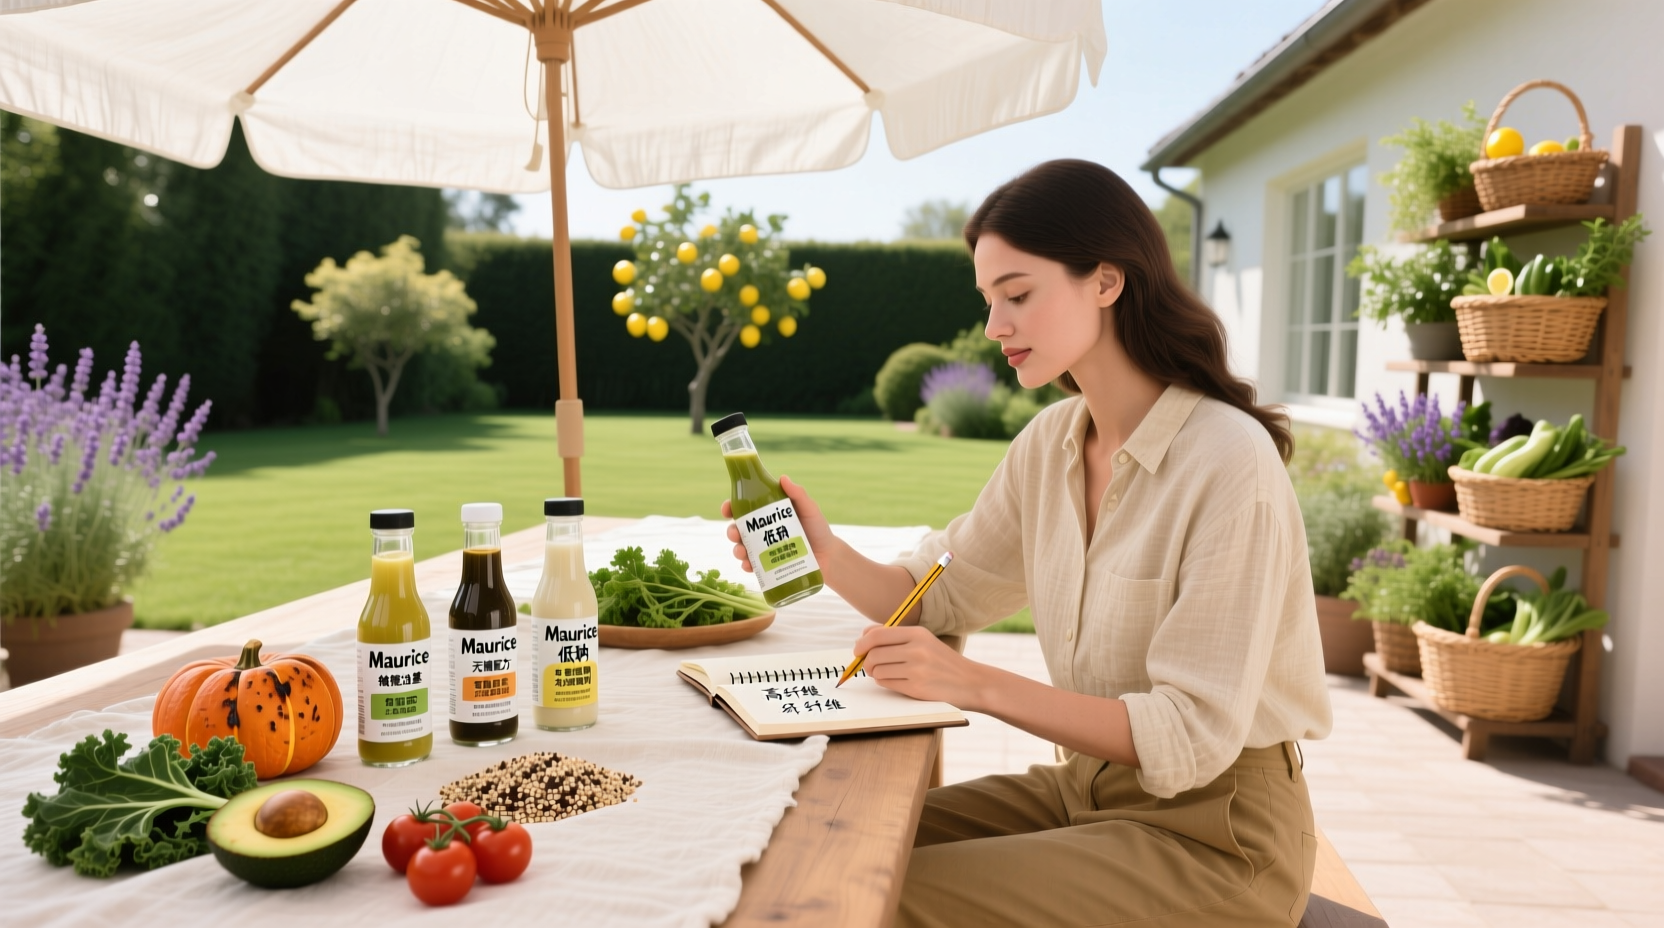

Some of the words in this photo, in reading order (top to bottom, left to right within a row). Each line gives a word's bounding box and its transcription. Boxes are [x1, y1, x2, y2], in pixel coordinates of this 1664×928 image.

[745, 507, 793, 533] Maurice
[545, 623, 598, 642] Maurice
[461, 635, 517, 655] Maurice
[368, 648, 430, 669] Maurice
